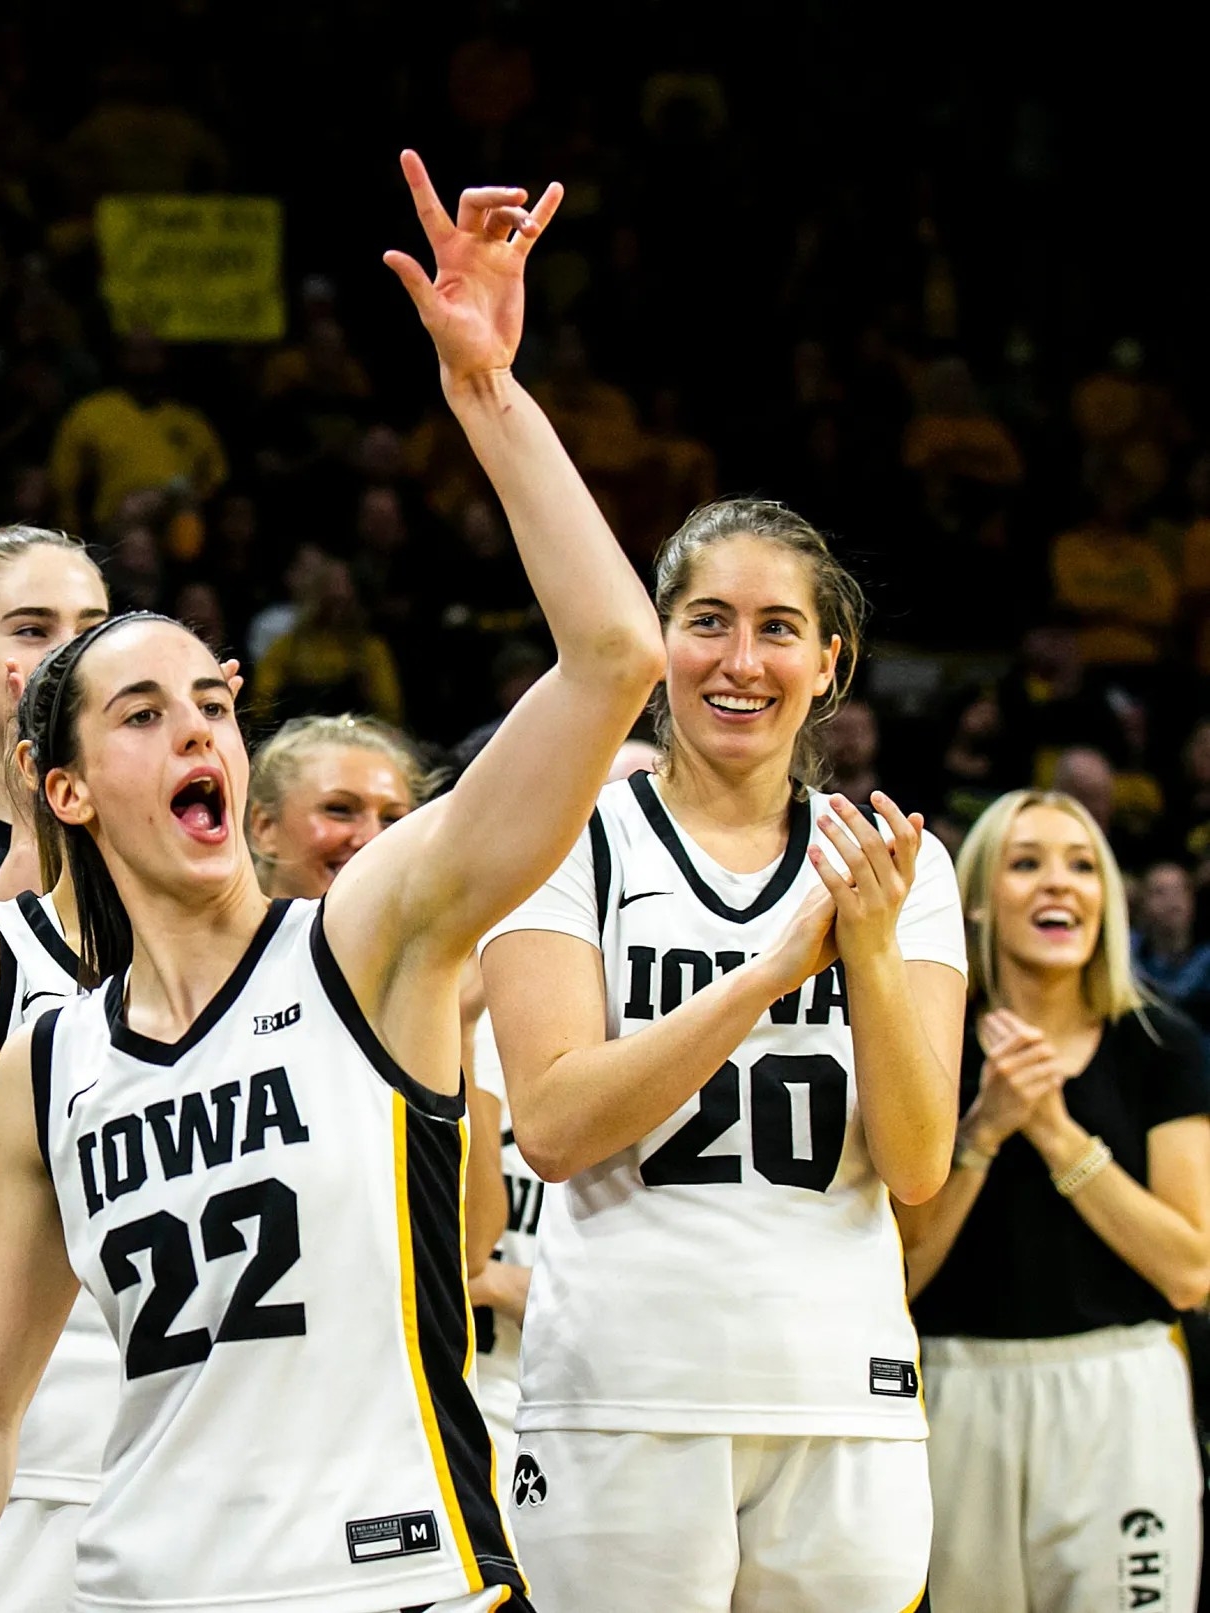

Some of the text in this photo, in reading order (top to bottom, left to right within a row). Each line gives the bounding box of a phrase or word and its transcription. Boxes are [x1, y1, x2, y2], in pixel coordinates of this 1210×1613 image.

[76, 1066, 310, 1219] IOWA
[639, 1053, 848, 1194] 20
[99, 1177, 307, 1381] 22
[907, 1372, 914, 1387] L
[410, 1523, 428, 1542] M
[1128, 1551, 1161, 1609] HA
